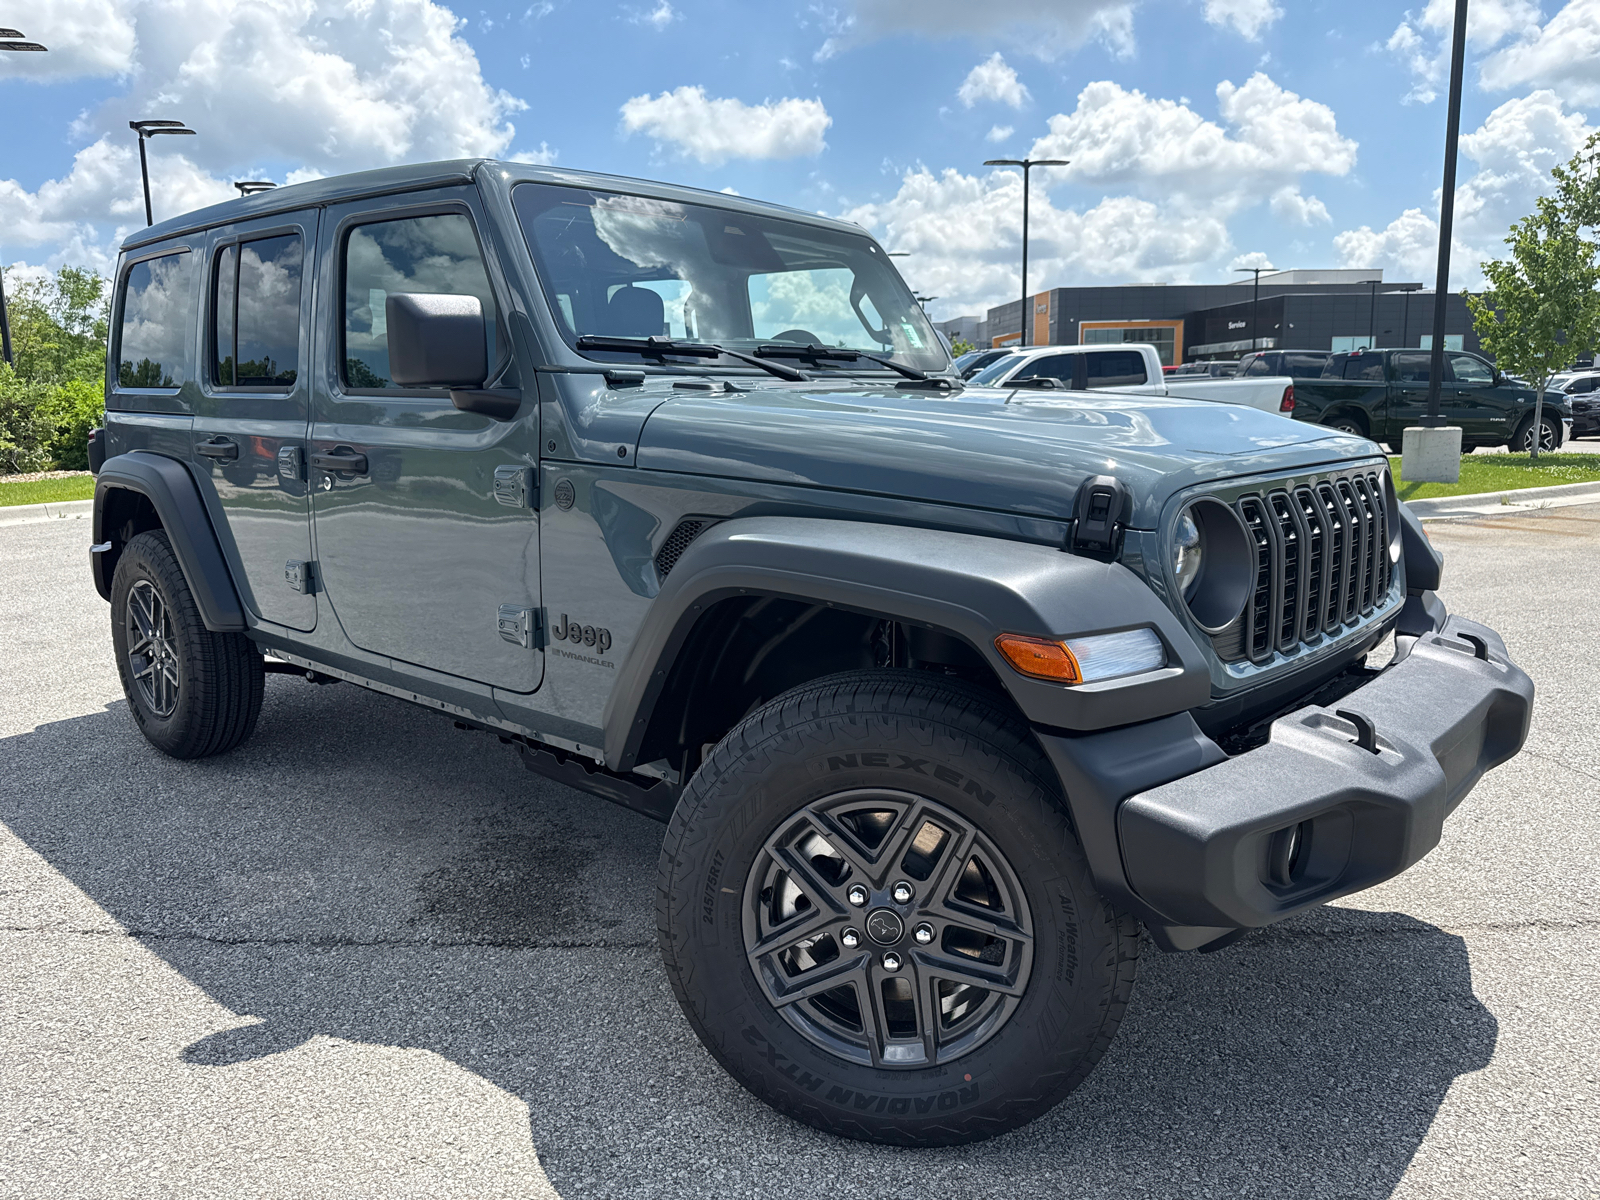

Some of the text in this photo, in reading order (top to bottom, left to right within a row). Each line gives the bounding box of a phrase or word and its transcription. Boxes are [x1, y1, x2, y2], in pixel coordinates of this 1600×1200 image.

[1228, 320, 1246, 329] Service
[552, 613, 611, 654] Jeep
[561, 651, 615, 669] WRANGLER
[826, 752, 997, 807] NEXEN
[702, 848, 726, 926] 245/75R17
[1056, 930, 1066, 982] Performance
[1058, 894, 1078, 987] All-Weather
[740, 1024, 824, 1092] HTX2
[824, 1082, 980, 1115] ROADIAN
